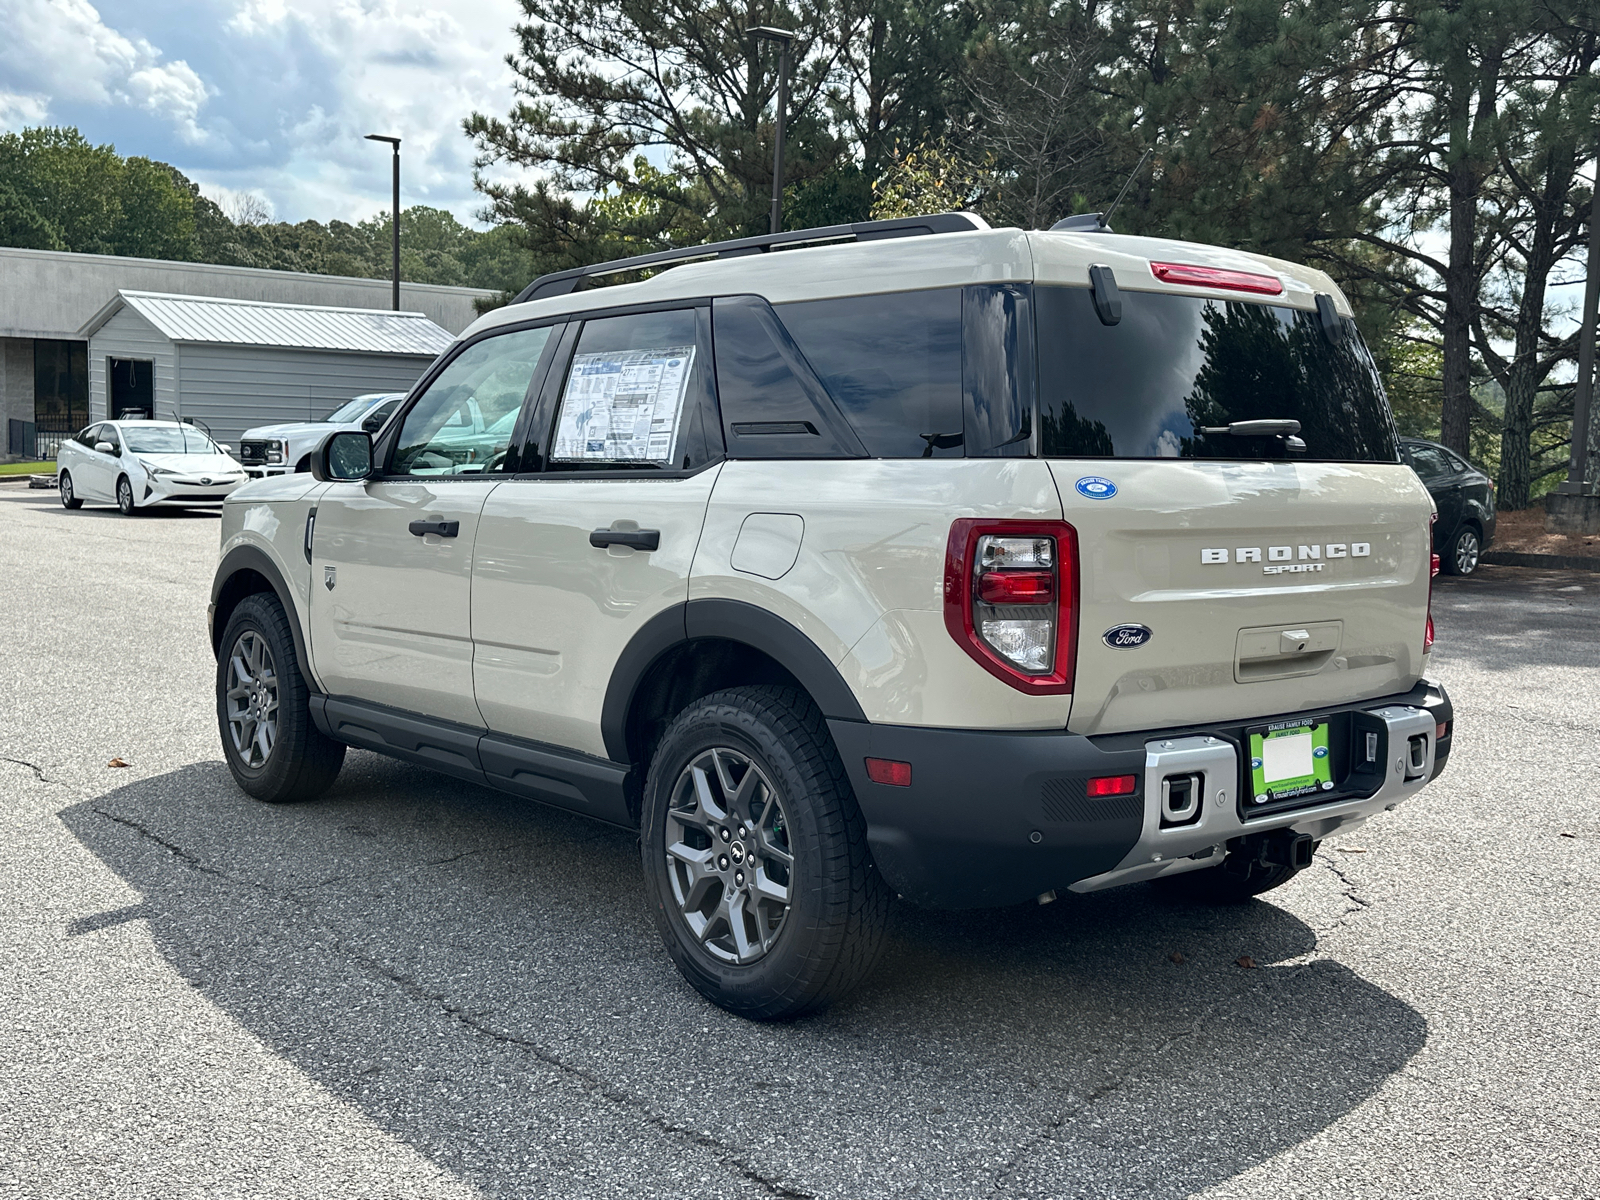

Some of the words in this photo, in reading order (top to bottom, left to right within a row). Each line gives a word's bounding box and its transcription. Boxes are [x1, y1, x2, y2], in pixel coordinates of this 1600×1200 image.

[1201, 542, 1371, 564] BRONCO
[1263, 563, 1326, 575] SPORT
[1116, 629, 1144, 645] Ford
[1268, 723, 1285, 731] KRAUSE
